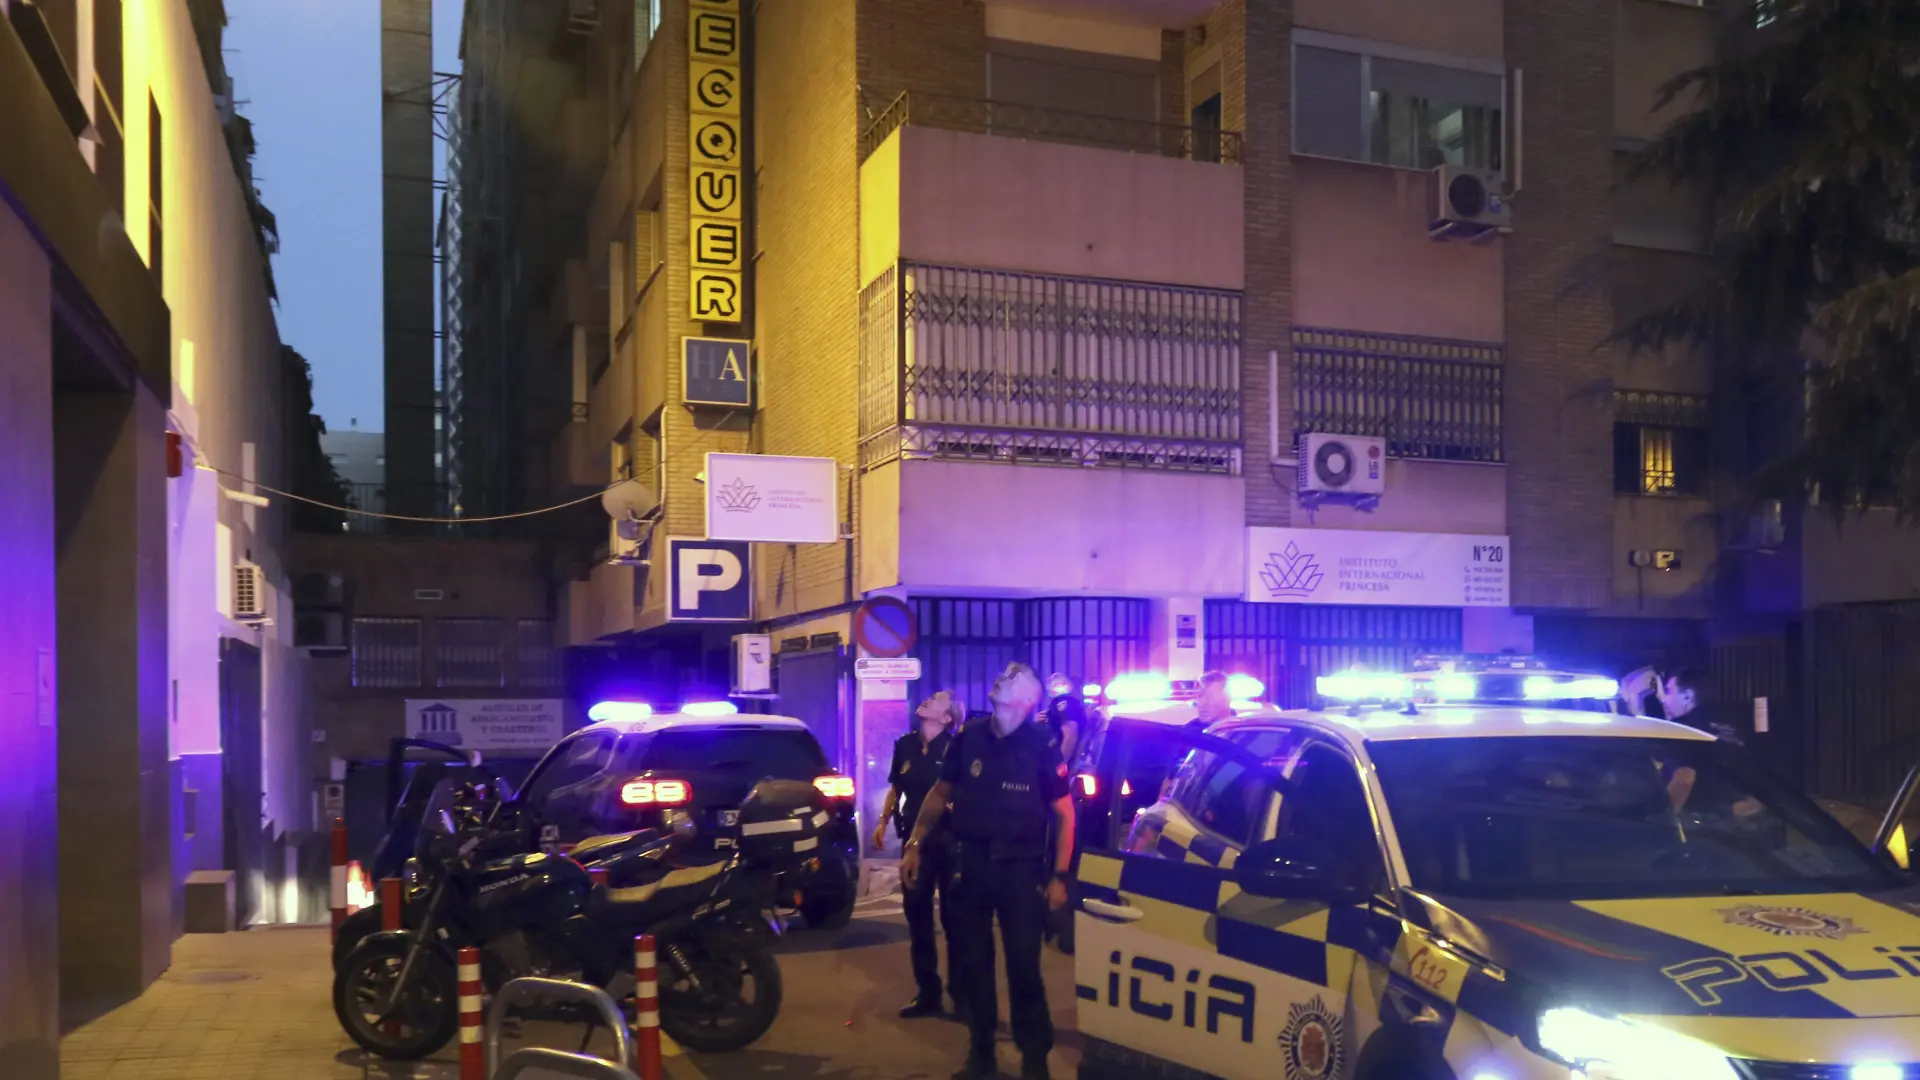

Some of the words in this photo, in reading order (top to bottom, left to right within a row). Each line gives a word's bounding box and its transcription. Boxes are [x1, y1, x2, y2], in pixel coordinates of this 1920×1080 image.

[695, 0, 737, 316] ECQUER
[1339, 557, 1397, 568] INSTITUTO
[679, 548, 742, 610] P
[1339, 569, 1425, 581] INTERNACIONAL
[1339, 581, 1390, 591] PRINCESA
[1415, 960, 1448, 990] 112
